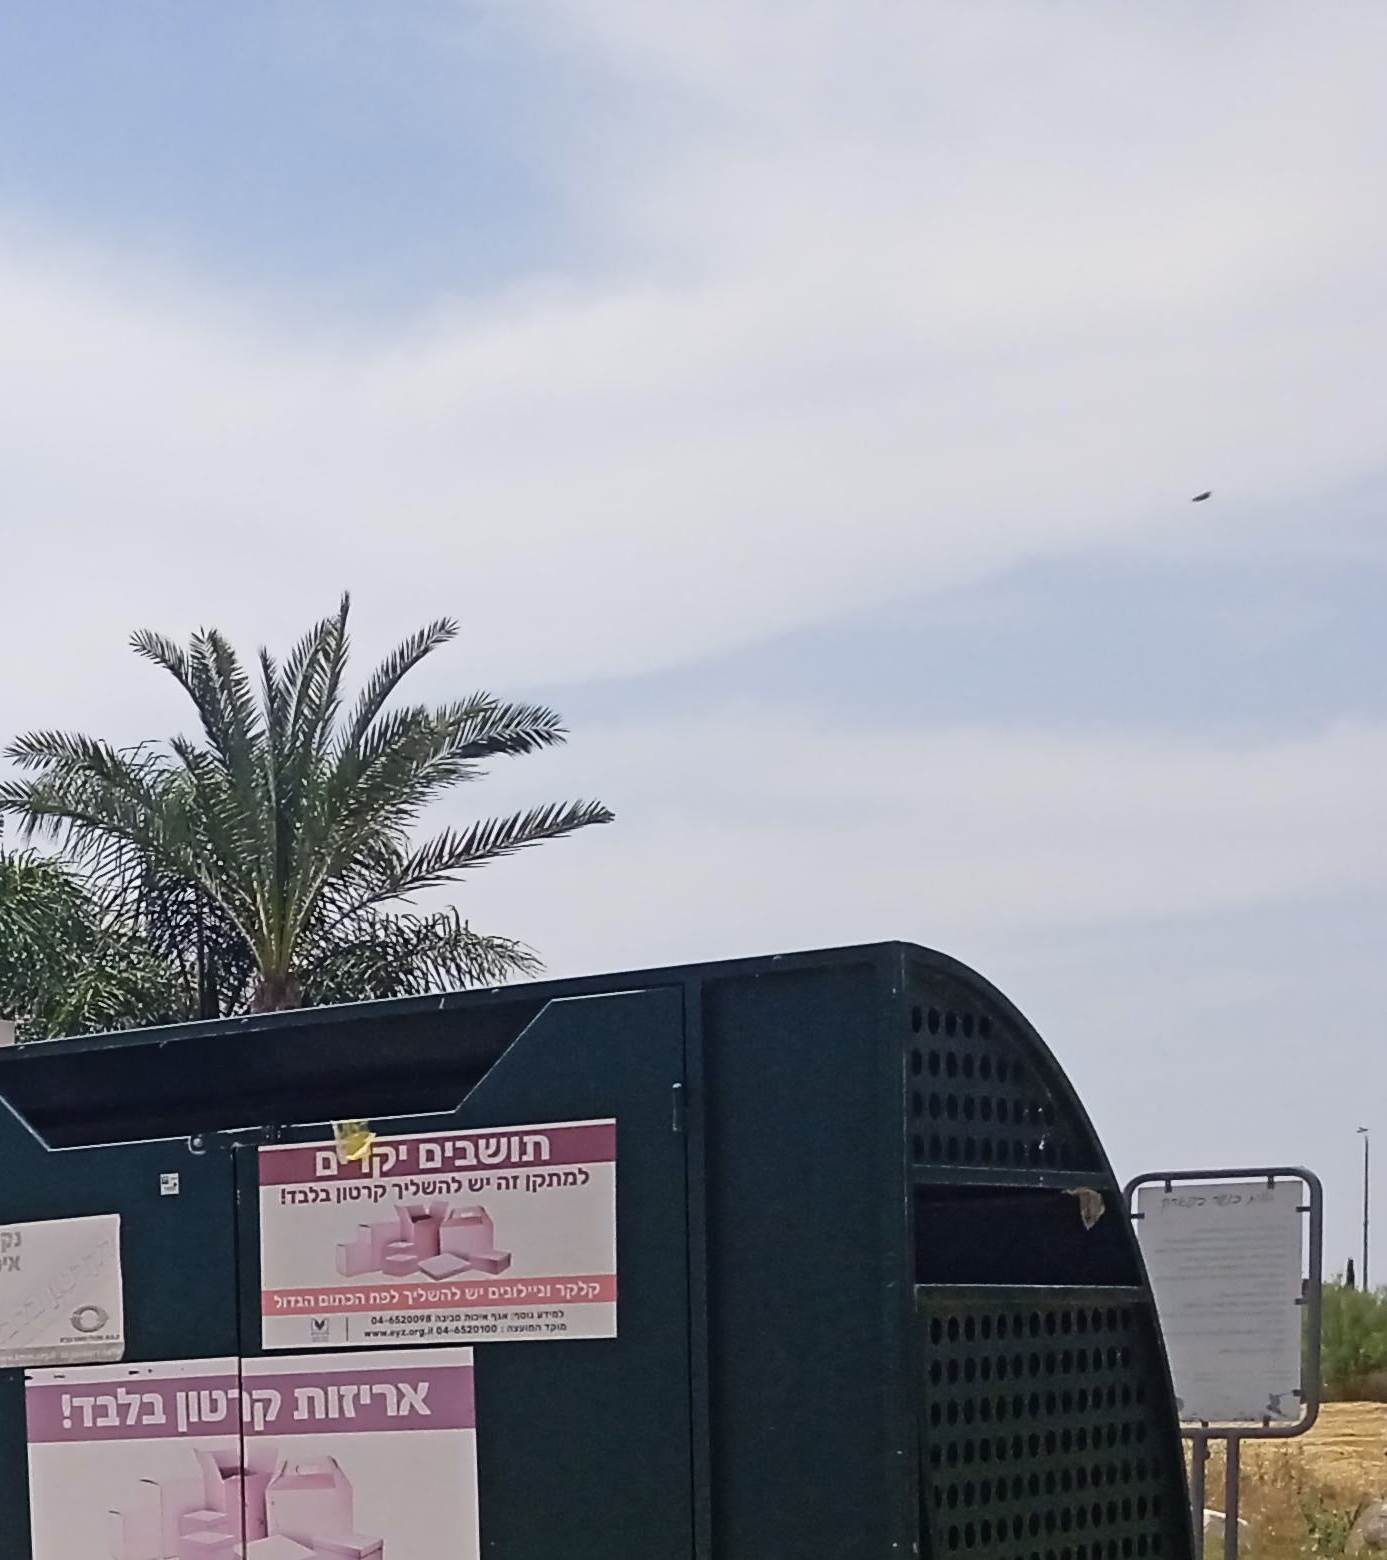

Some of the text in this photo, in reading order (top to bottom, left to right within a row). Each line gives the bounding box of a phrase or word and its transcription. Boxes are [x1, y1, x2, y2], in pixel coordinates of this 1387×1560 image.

[419, 1134, 550, 1169] תושבים
[280, 1168, 590, 1205] למתקן זה יש להשליך קרטון בלבד!
[273, 1282, 601, 1309] קלקר וניילונים יש להשליך לפח הכתום הגדול
[61, 1381, 432, 1432] אריזות קרטון בלבד!
